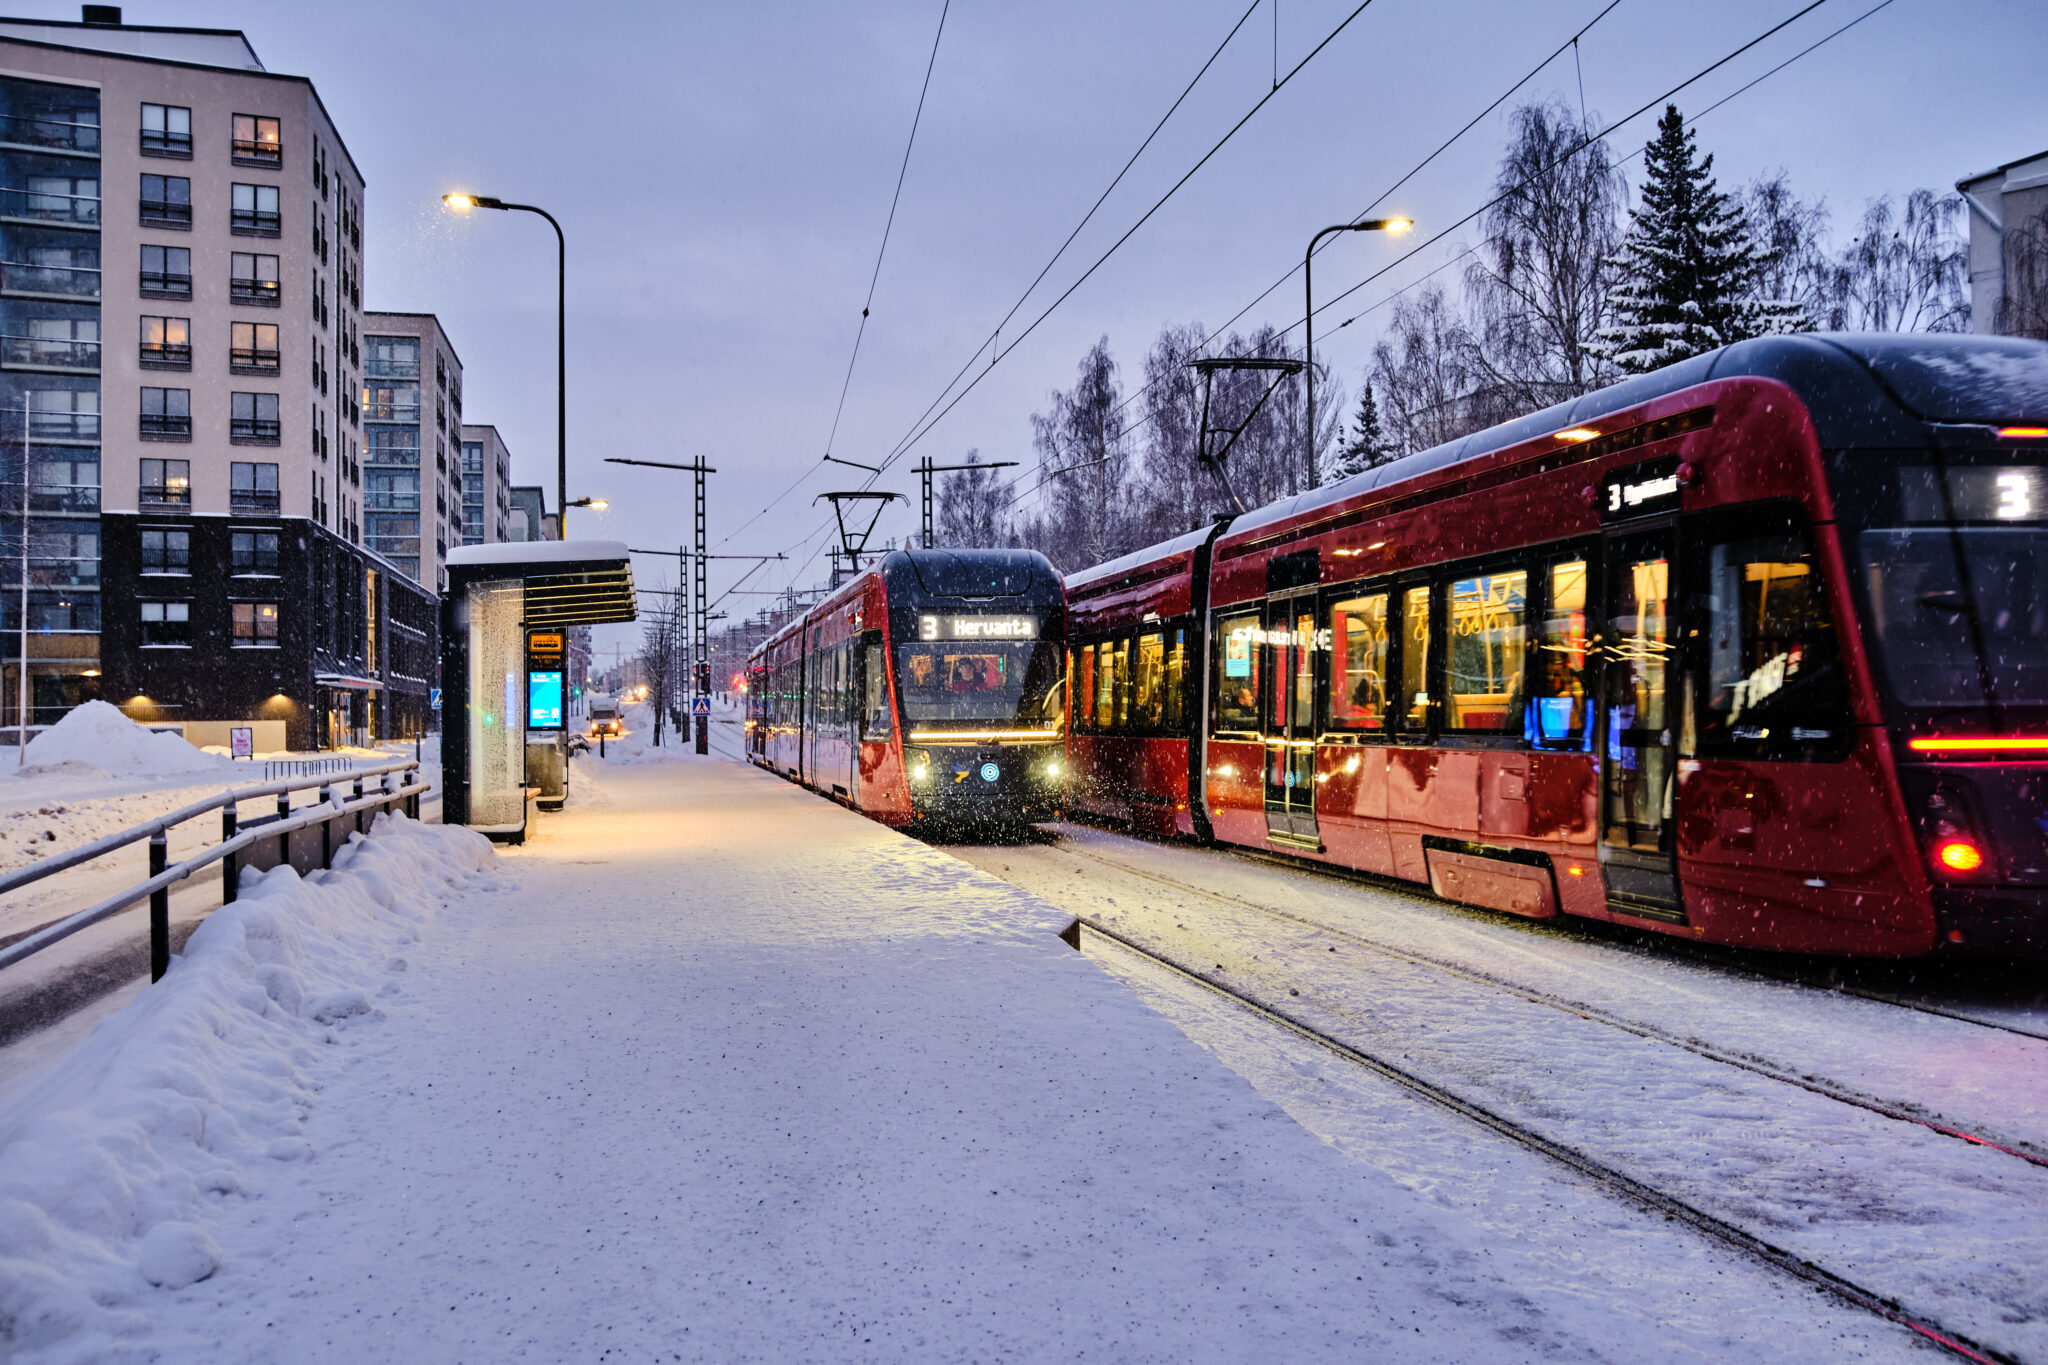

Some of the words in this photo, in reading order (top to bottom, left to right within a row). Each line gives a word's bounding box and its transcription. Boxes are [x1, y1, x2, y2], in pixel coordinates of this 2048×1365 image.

[1608, 484, 1621, 511] 3
[1996, 473, 2030, 518] 3
[922, 615, 938, 640] 3
[953, 618, 1032, 637] Hervanta
